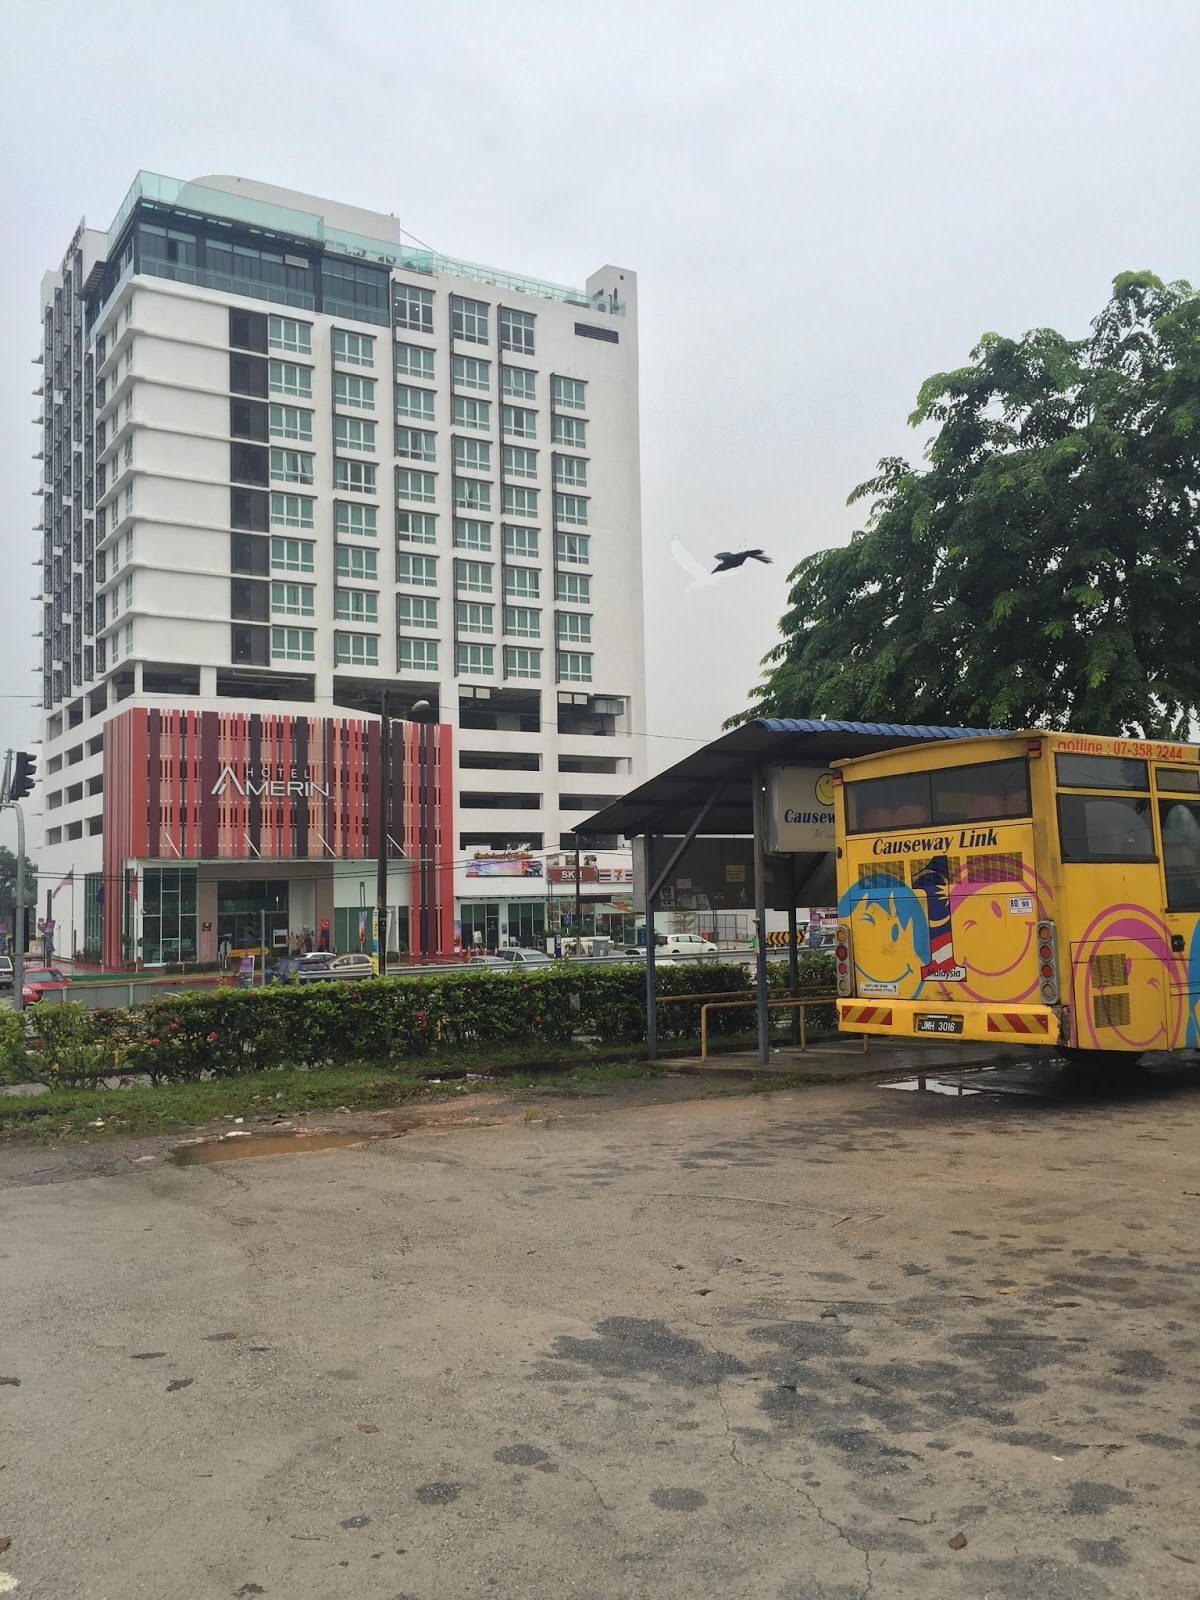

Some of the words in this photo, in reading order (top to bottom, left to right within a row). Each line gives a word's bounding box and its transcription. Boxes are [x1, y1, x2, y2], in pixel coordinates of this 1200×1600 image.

[1113, 742, 1152, 757] 07-358
[1156, 745, 1182, 760] 2244
[246, 767, 310, 778] HOTEL
[211, 766, 329, 796] AMERIN
[872, 837, 954, 855] Causeway
[959, 828, 998, 848] Link
[928, 967, 961, 979] Malaysia
[938, 1021, 956, 1032] 3016
